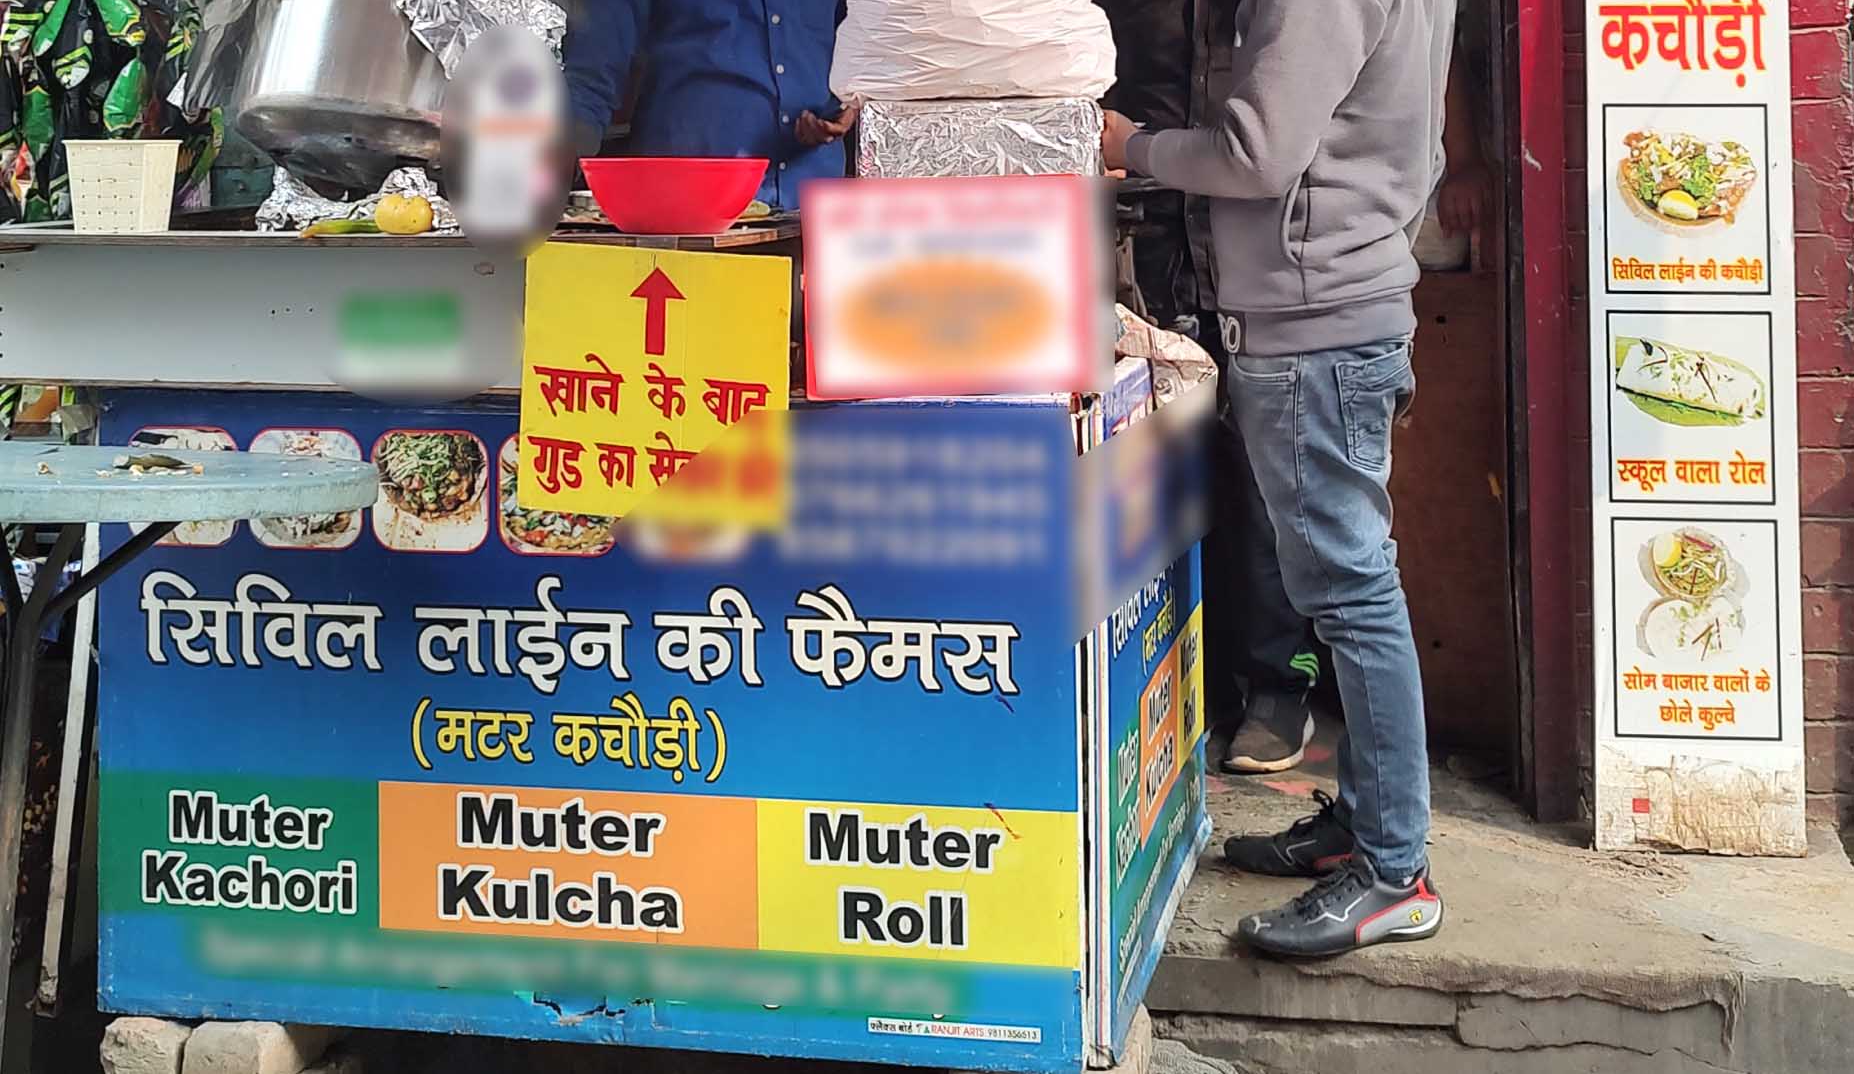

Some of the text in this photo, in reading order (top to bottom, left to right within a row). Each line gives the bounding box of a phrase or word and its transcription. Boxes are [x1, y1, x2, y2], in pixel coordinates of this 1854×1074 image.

[1612, 257, 1655, 280] सिविल
[1659, 257, 1695, 284] लाईन
[1700, 258, 1717, 280] की
[533, 353, 624, 416] खाने
[643, 362, 687, 420] के
[595, 442, 638, 488] का
[1617, 450, 1766, 492] स्कूल वाला रोल
[138, 569, 1022, 696] सिविल लाईन की फैमस
[1623, 666, 1657, 690] सोम
[1662, 673, 1709, 691] बाजार
[1755, 668, 1771, 692] के
[1659, 698, 1735, 730] छोले कुल्चे
[167, 789, 334, 850] Muter
[456, 792, 666, 858] Muter
[804, 806, 1002, 875] Muter
[141, 850, 358, 915] Kachori
[437, 863, 686, 934] Kulcha
[837, 884, 969, 951] Roll
